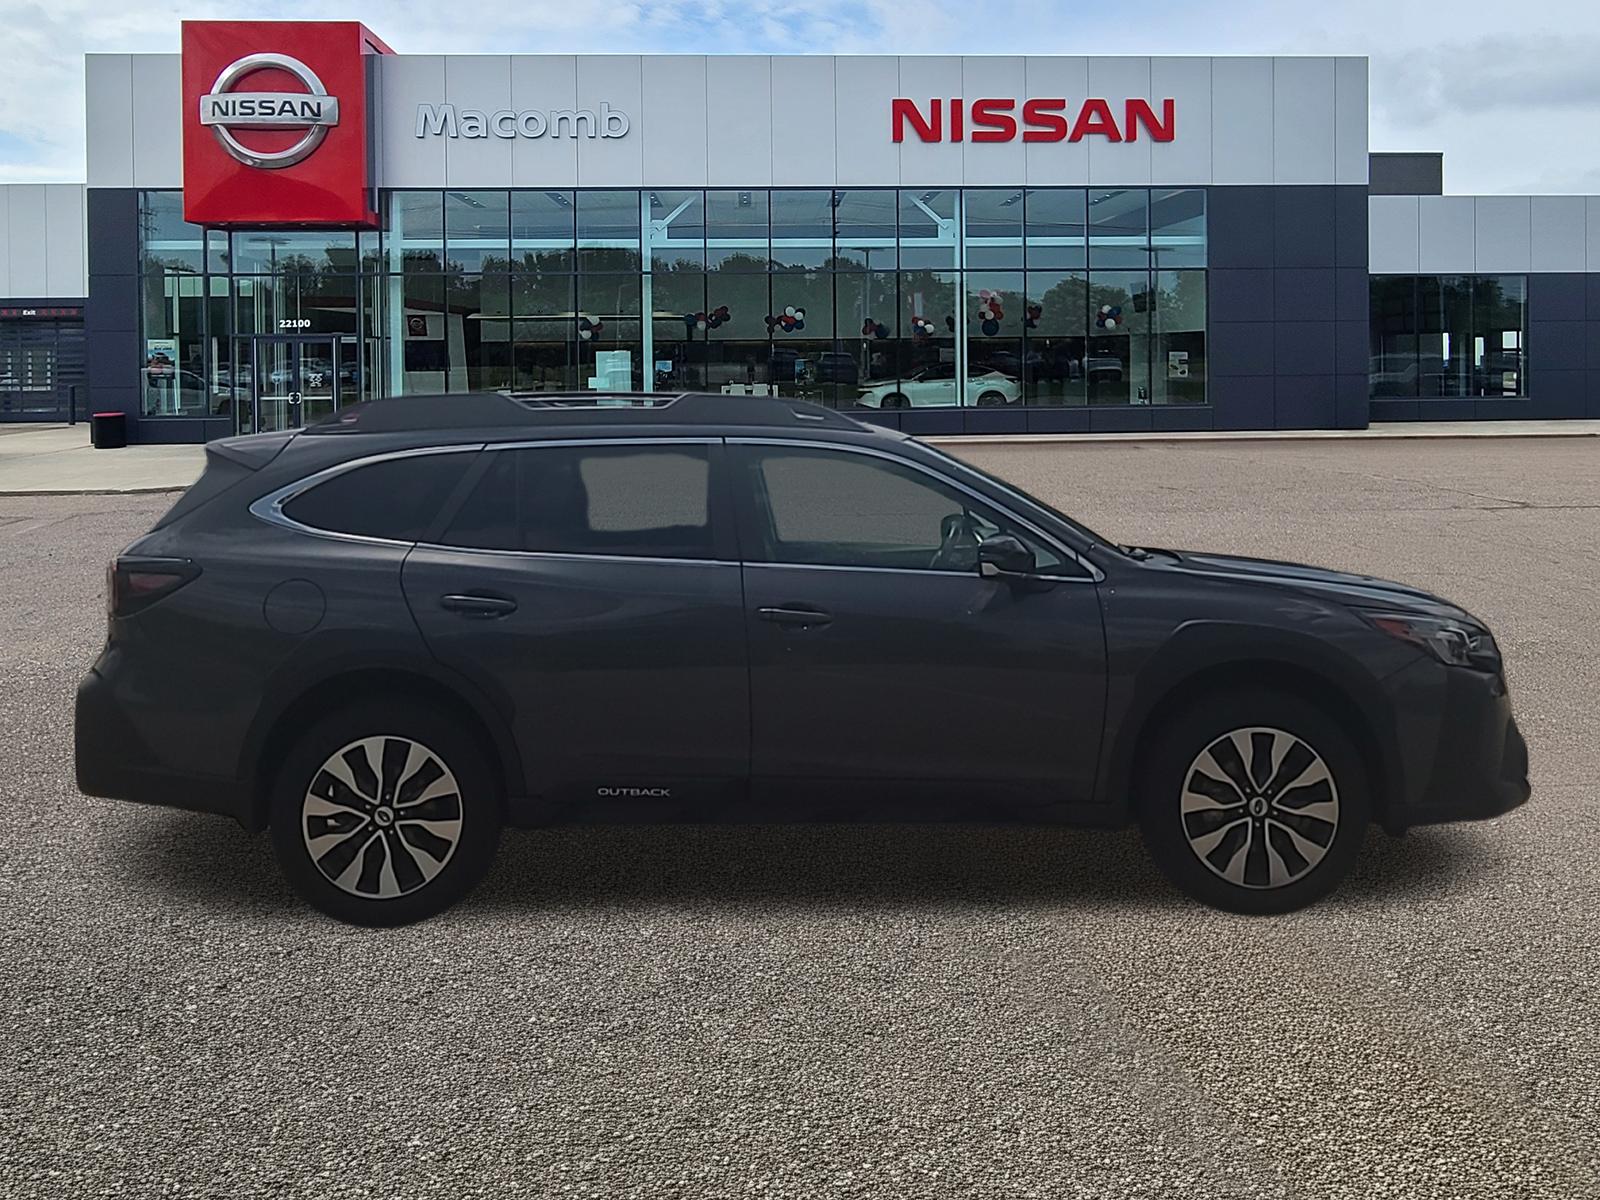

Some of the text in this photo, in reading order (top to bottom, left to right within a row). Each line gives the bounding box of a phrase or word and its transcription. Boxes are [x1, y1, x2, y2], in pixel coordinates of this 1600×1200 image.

[211, 100, 322, 117] NISSAN
[415, 102, 631, 140] Macomb
[892, 98, 1176, 143] NISSAN
[279, 319, 311, 328] 22100
[597, 787, 671, 797] OUTBACK
